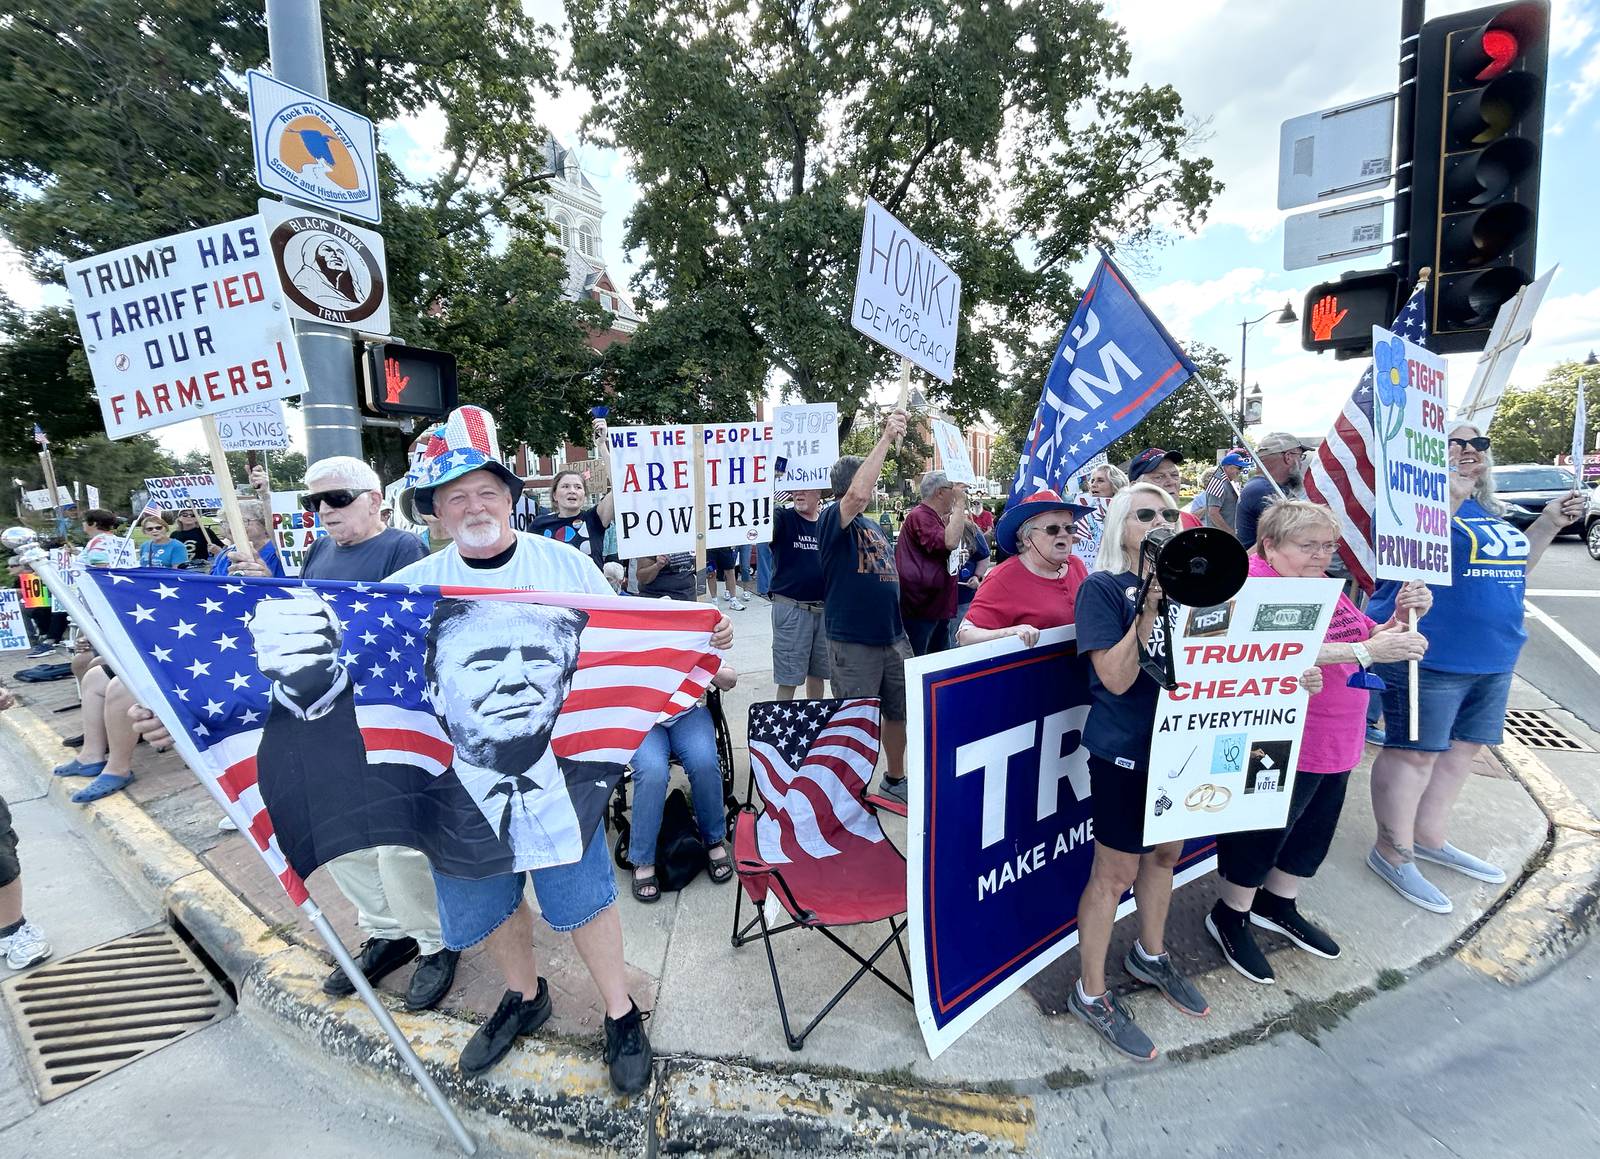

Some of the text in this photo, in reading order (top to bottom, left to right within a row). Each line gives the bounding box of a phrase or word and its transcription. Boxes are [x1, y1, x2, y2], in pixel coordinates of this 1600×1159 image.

[280, 105, 353, 149] Rock River Trail
[270, 157, 368, 200] Scenic and Historic Route
[289, 218, 365, 252] BLACK HAWK
[76, 226, 260, 298] TRUMP HAS
[869, 213, 957, 329] HONK!
[86, 271, 265, 341] TARRIFFIED
[318, 306, 351, 322] TRAIL
[898, 303, 920, 327] FOR
[144, 325, 216, 370] OUR
[861, 298, 951, 369] DEMOCRACY
[110, 341, 291, 425] FARMERS!
[1407, 358, 1445, 399] FIGHT
[239, 421, 284, 438] KINGS
[780, 410, 834, 436] STOP
[1422, 399, 1445, 434] FOR
[611, 426, 774, 448] WE THE PEOPLE
[783, 439, 819, 458] THE
[1404, 427, 1446, 468] THOSE
[622, 460, 689, 493] ARE
[706, 455, 767, 487] THE
[778, 467, 832, 482] NSANIT
[1388, 460, 1447, 503] WITHOUT
[151, 488, 190, 499] NO ICE
[156, 500, 172, 510] NO
[1415, 502, 1448, 538] YOUR
[279, 531, 295, 548] IS
[1377, 534, 1449, 574] PRIVILEGE
[1477, 523, 1531, 557] JB
[1195, 609, 1227, 629] TEST
[1183, 642, 1304, 665] TRUMP
[1167, 676, 1298, 702] CHEATS
[1158, 707, 1297, 733] AT EVERYTHING
[955, 704, 1092, 850] TR
[1257, 780, 1277, 791] VOTE
[977, 817, 1095, 902] MAKE AME
